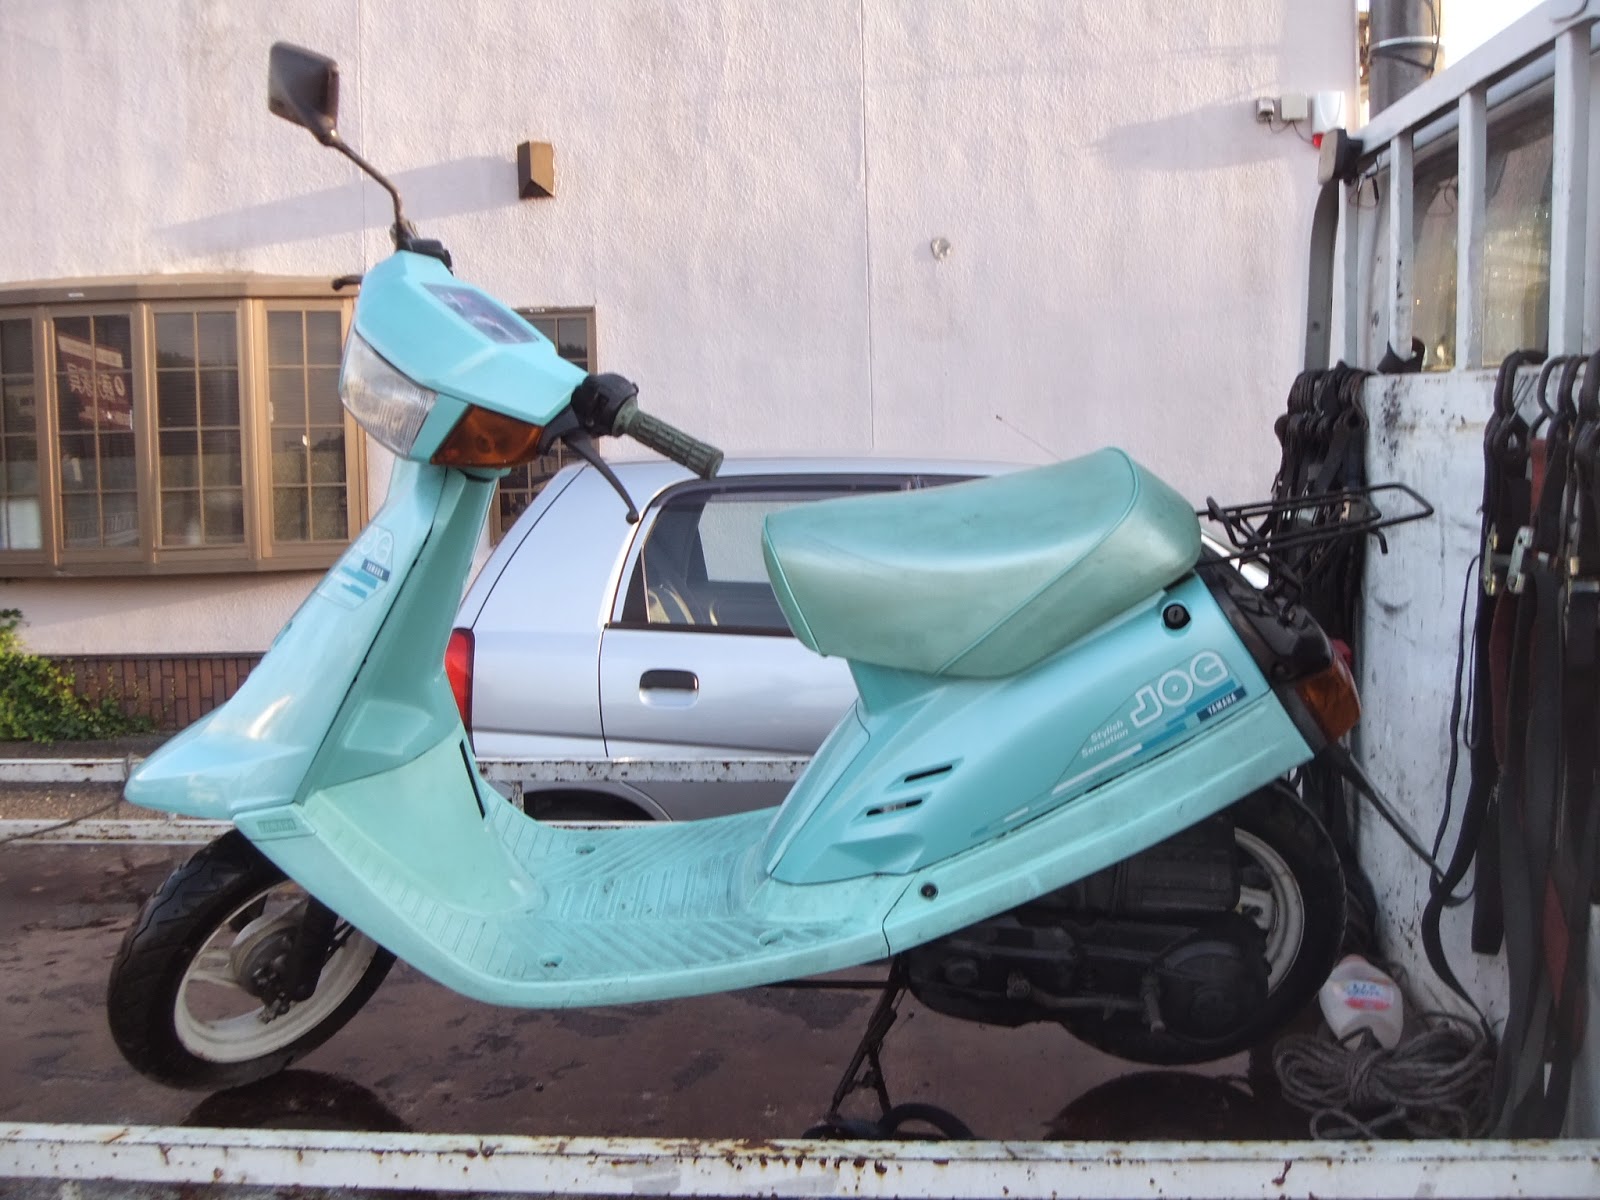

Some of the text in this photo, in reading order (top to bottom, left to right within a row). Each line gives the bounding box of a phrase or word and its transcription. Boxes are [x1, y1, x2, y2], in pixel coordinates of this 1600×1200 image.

[1130, 650, 1229, 728] JOG
[1207, 693, 1238, 716] YAMAHA
[1081, 729, 1129, 758] Sensation
[1090, 720, 1124, 743] Stylish
